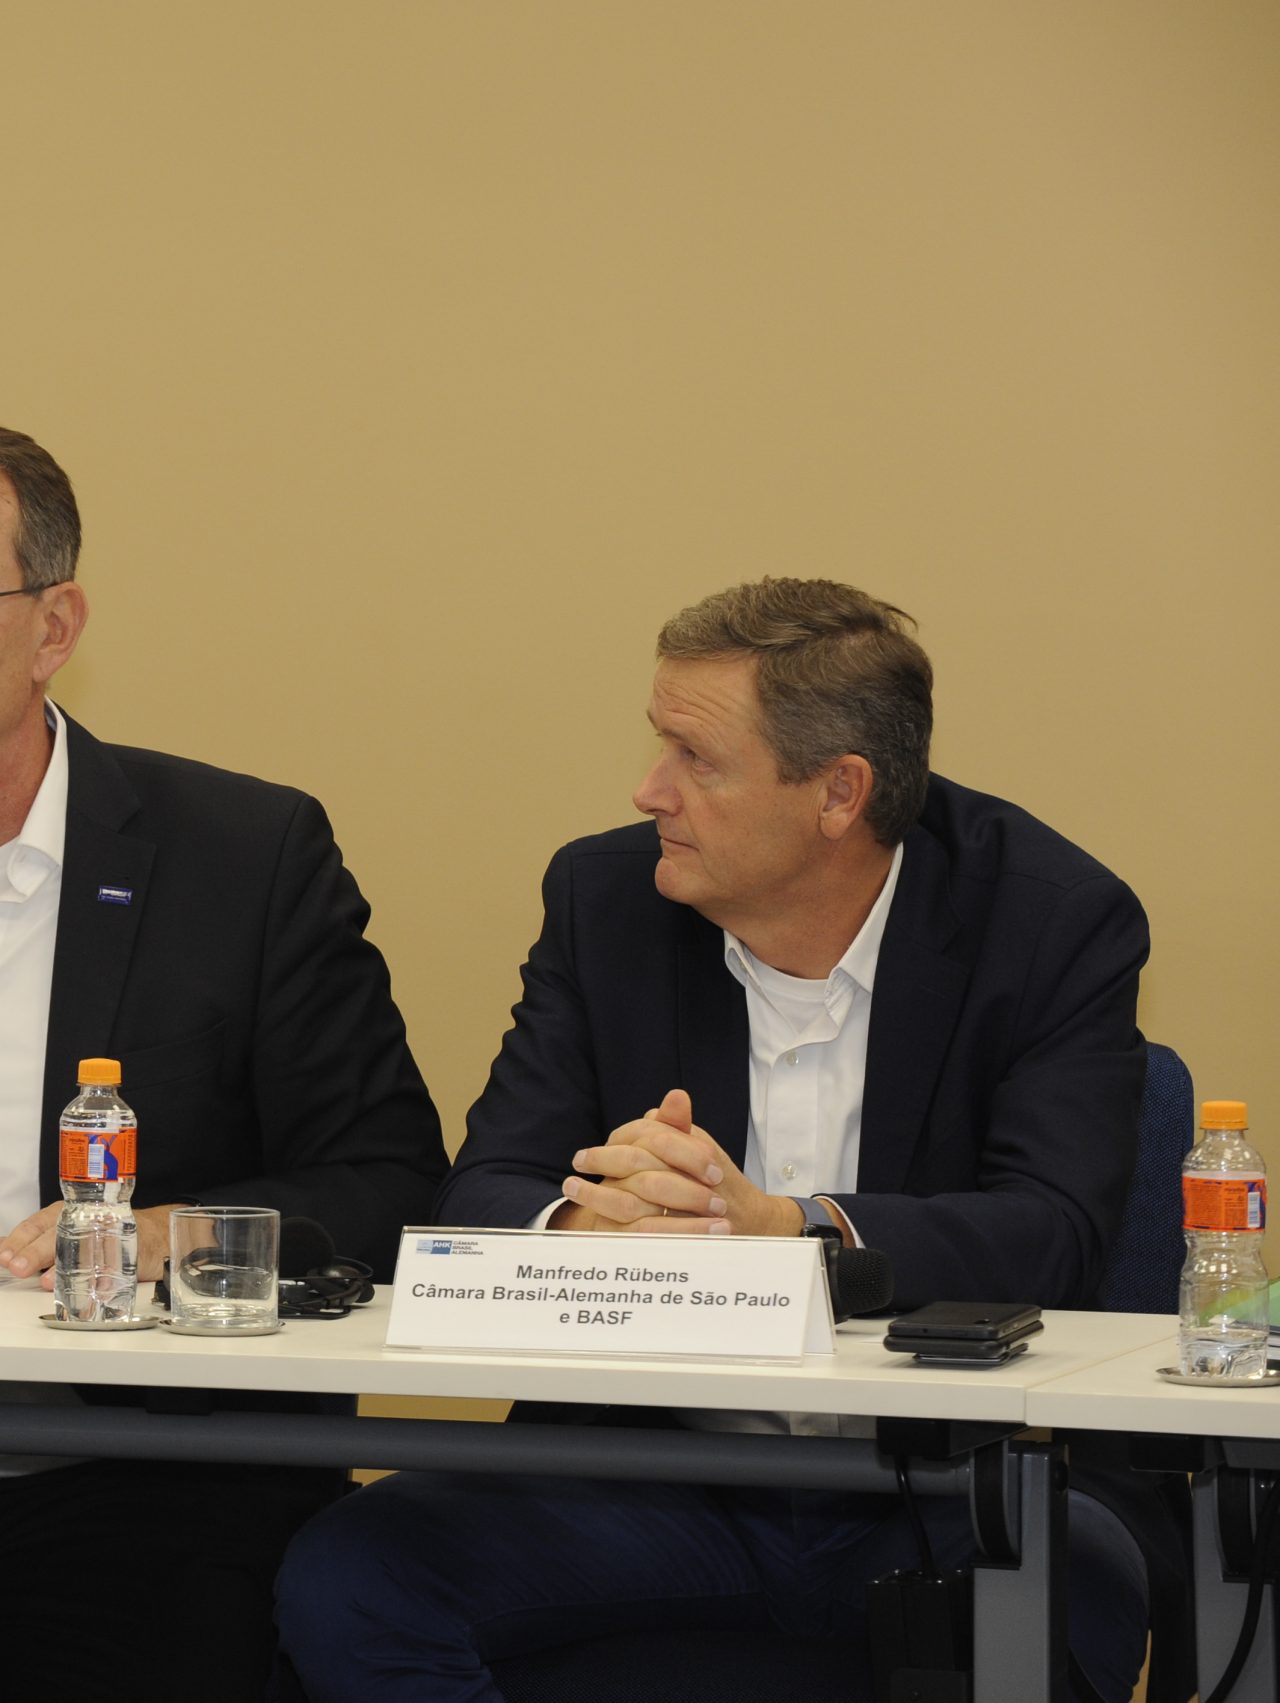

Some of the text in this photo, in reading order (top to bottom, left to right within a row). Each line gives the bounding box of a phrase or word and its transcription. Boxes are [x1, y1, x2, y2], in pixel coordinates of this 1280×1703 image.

[516, 1265, 689, 1283] Manfredo Rübens
[412, 1283, 790, 1307] Câmara Brasil-Alemanha de São Paulo
[559, 1310, 633, 1325] e BASF
